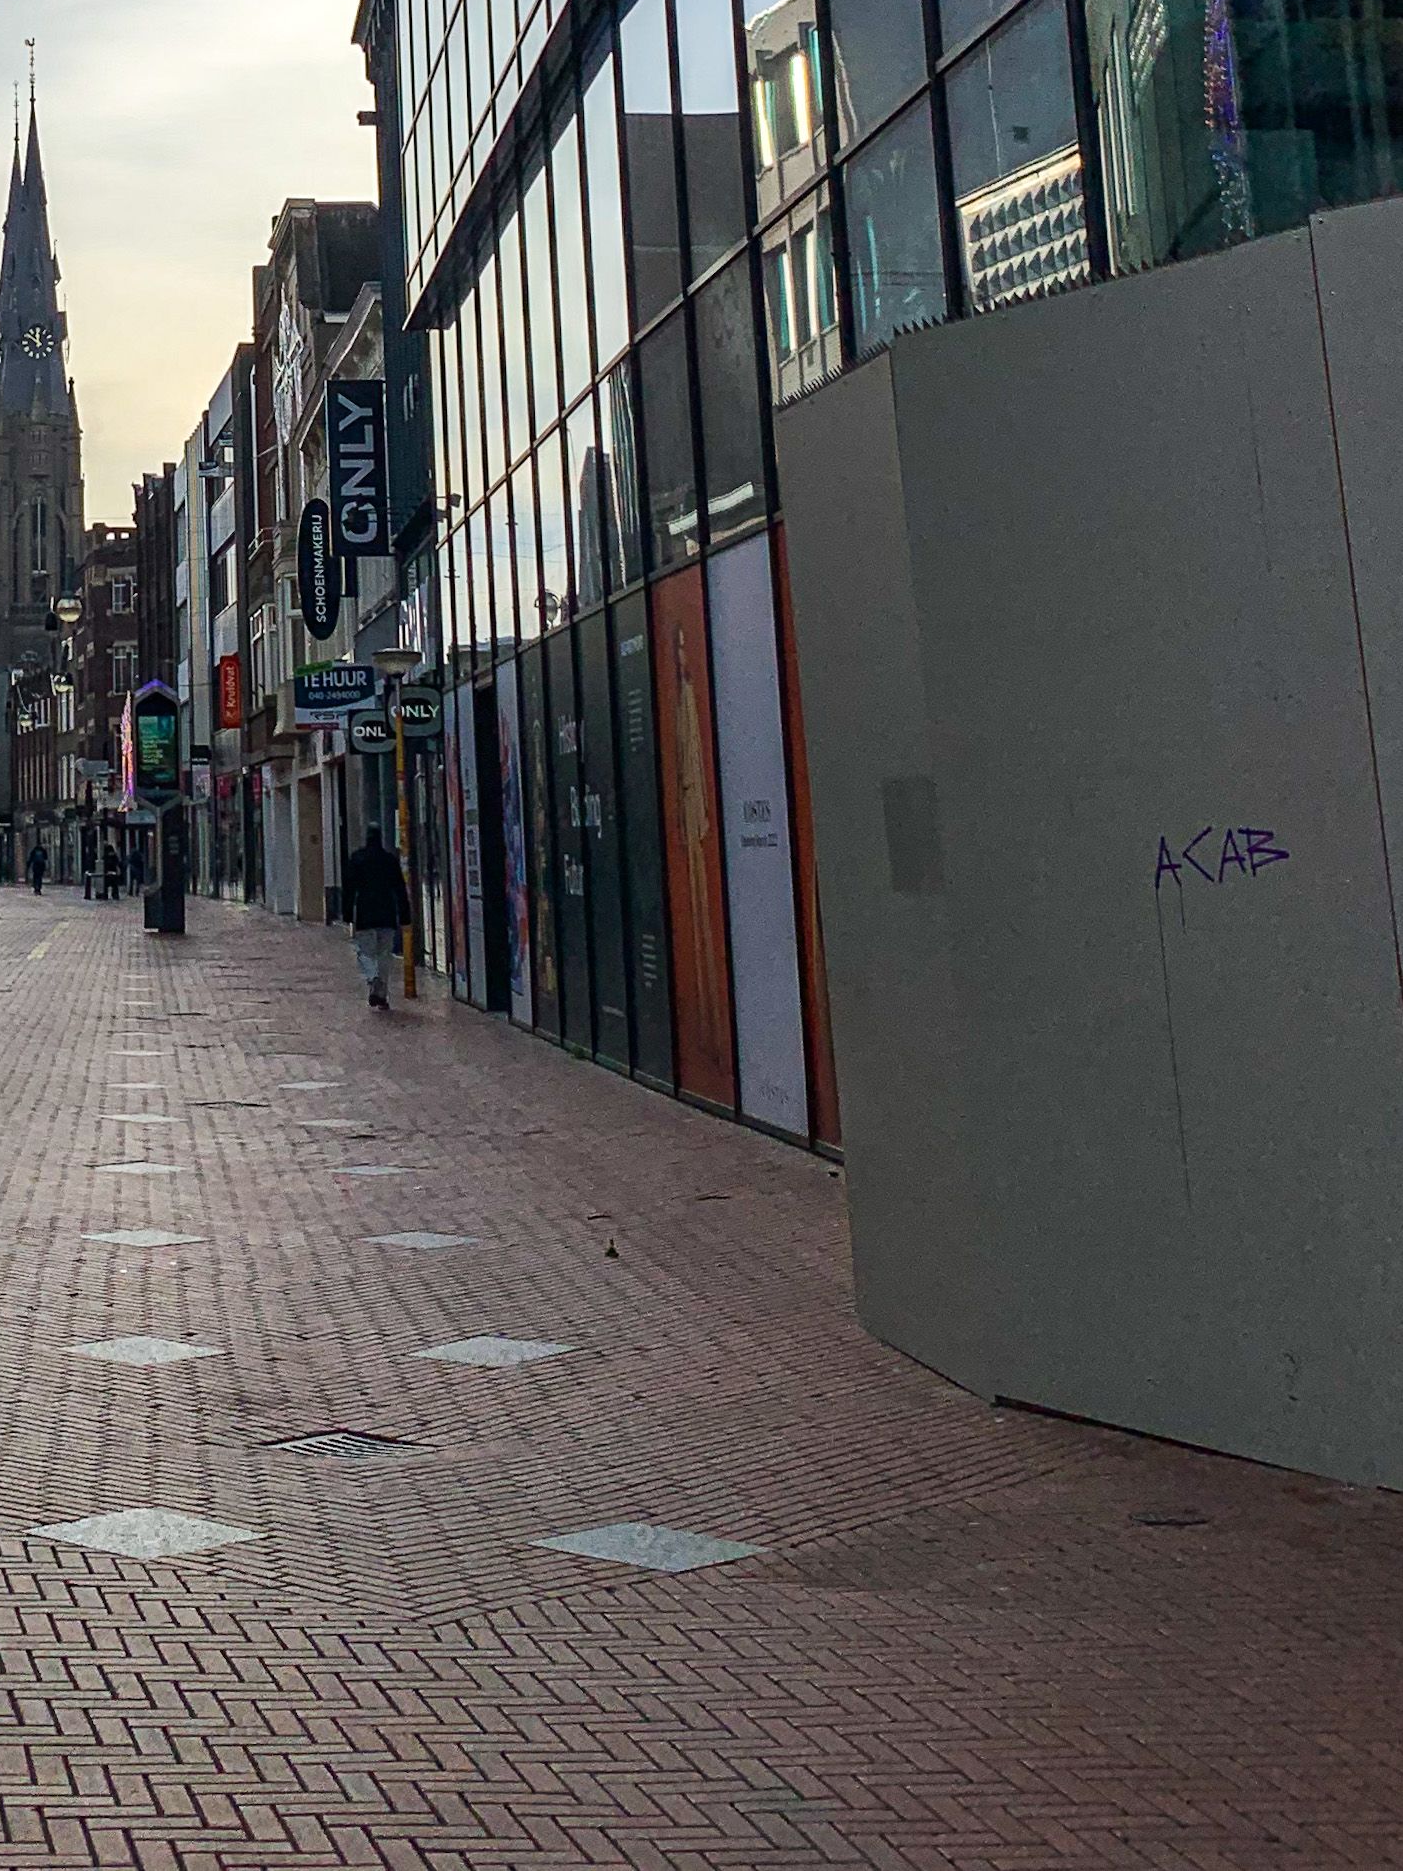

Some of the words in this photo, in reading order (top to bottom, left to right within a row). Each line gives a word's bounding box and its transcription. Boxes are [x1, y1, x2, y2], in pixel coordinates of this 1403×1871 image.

[337, 393, 378, 543] ONLY
[313, 514, 327, 623] SCHOENMAKERIJ
[226, 666, 236, 708] Kruidvat
[322, 671, 367, 686] HUUR
[390, 705, 439, 718] ONLY
[1155, 827, 1289, 889] ACAB
